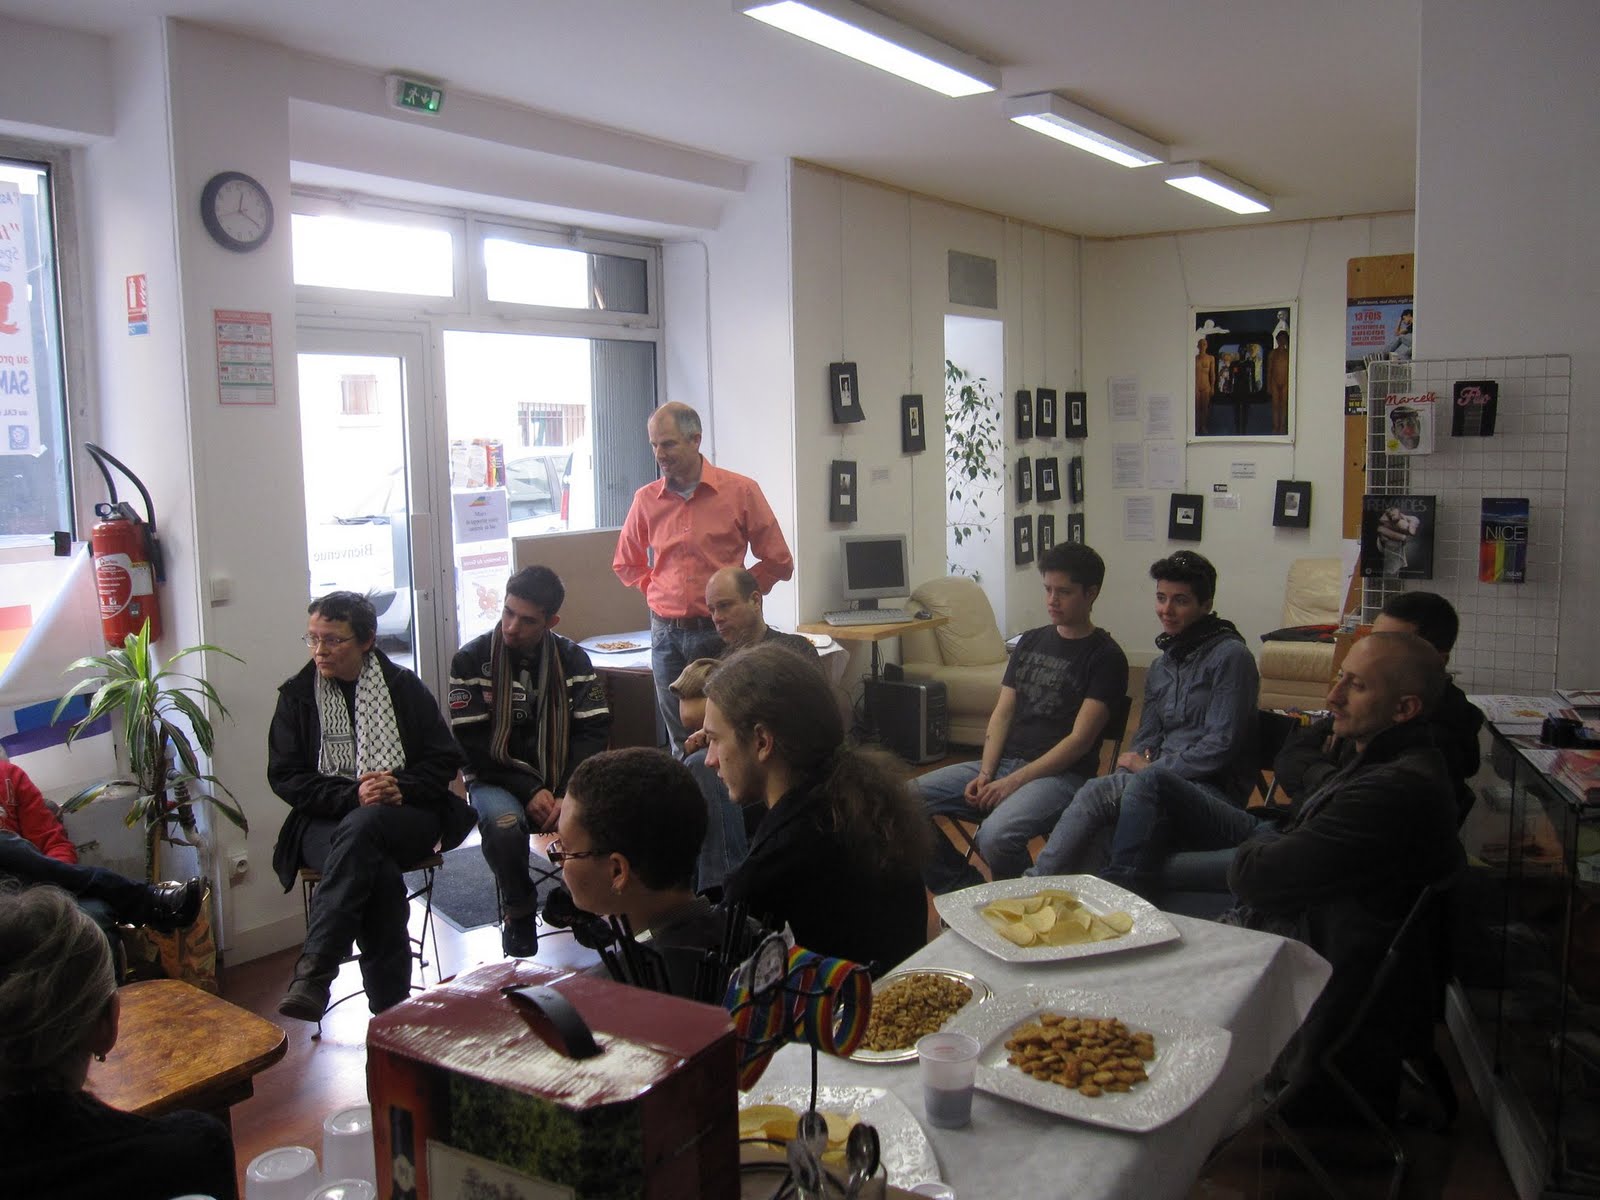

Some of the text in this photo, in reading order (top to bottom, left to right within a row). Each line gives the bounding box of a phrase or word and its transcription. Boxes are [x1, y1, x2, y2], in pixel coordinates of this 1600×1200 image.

[1354, 311, 1382, 321] 13 FOIS
[1486, 525, 1525, 541] NICE
